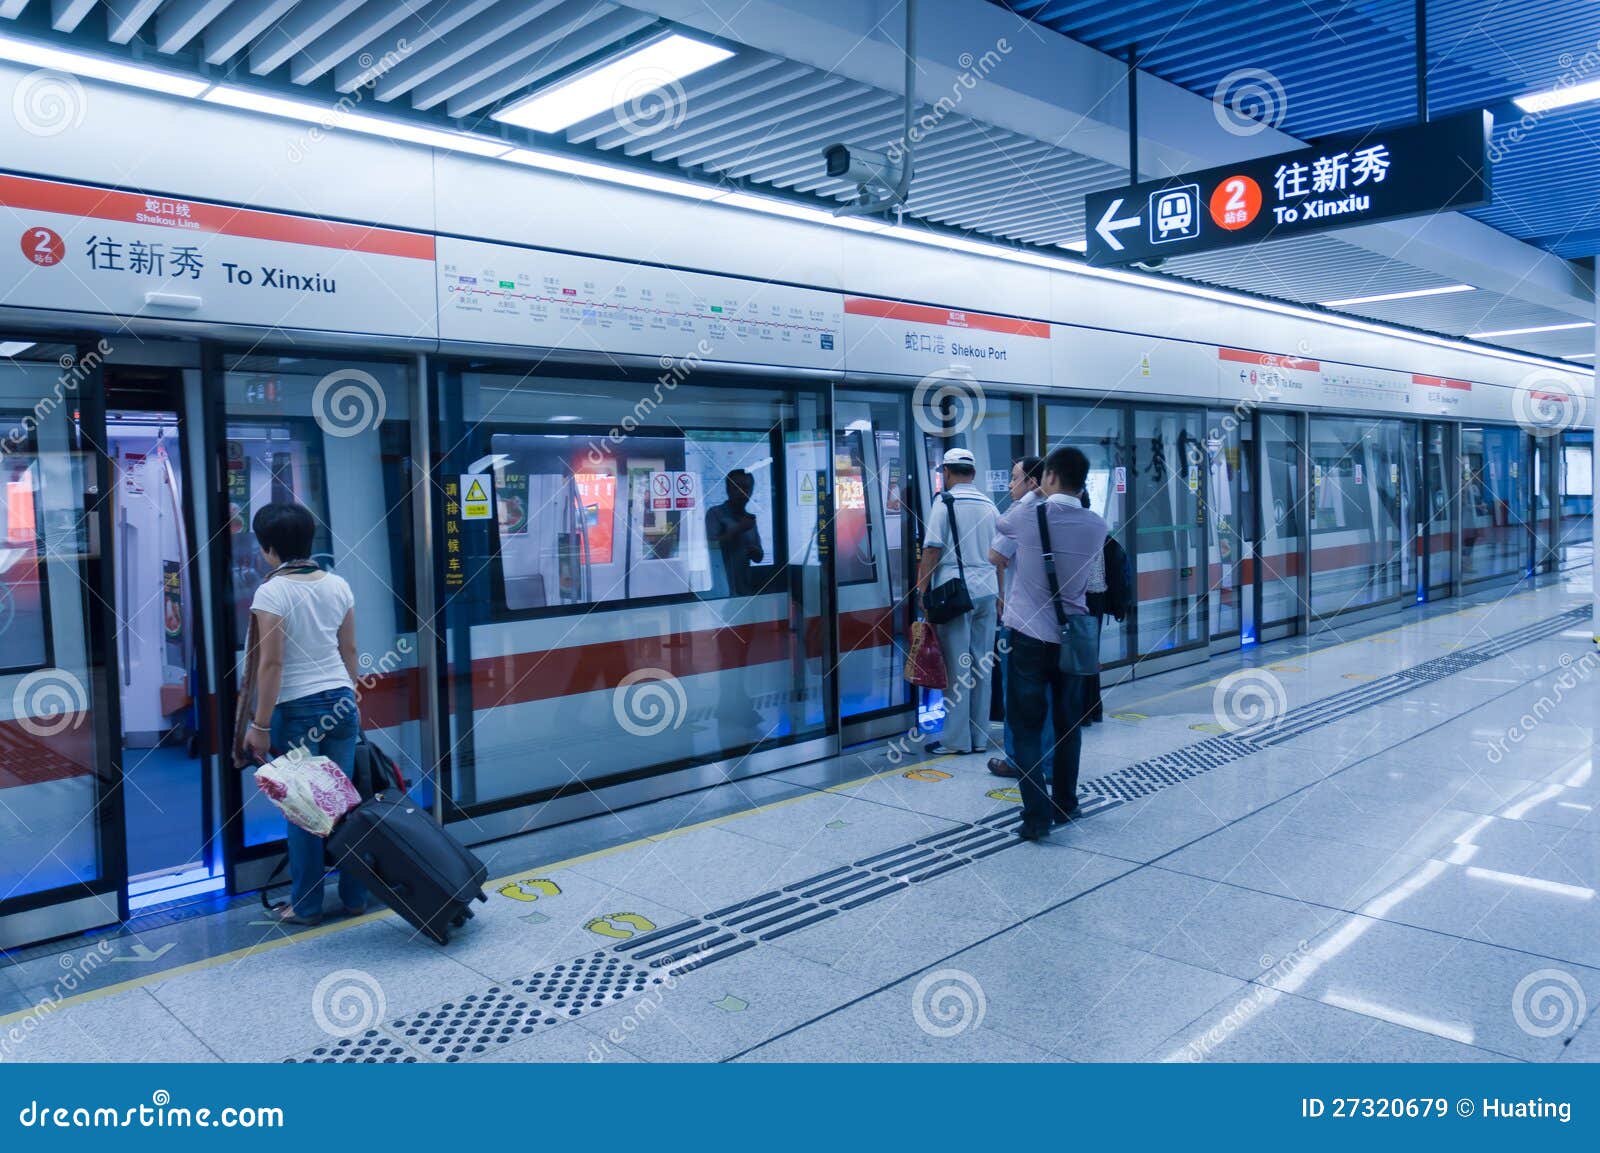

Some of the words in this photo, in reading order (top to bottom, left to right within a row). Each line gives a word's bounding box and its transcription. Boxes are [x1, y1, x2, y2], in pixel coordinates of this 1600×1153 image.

[1274, 144, 1391, 200] 往新秀
[1225, 180, 1246, 211] 2
[145, 198, 191, 217] 蛇口线
[1224, 209, 1248, 224] 站台
[1273, 207, 1298, 225] To
[1302, 194, 1370, 221] Xinxiu
[136, 212, 176, 226] Shekou
[178, 218, 201, 229] Line
[34, 230, 53, 253] 2
[86, 235, 204, 280] 往新秀
[222, 263, 253, 285] To
[261, 267, 337, 293] Xinxiu
[905, 331, 946, 354] 蛇口港
[951, 343, 986, 358] Shekou
[988, 347, 1008, 361] Port
